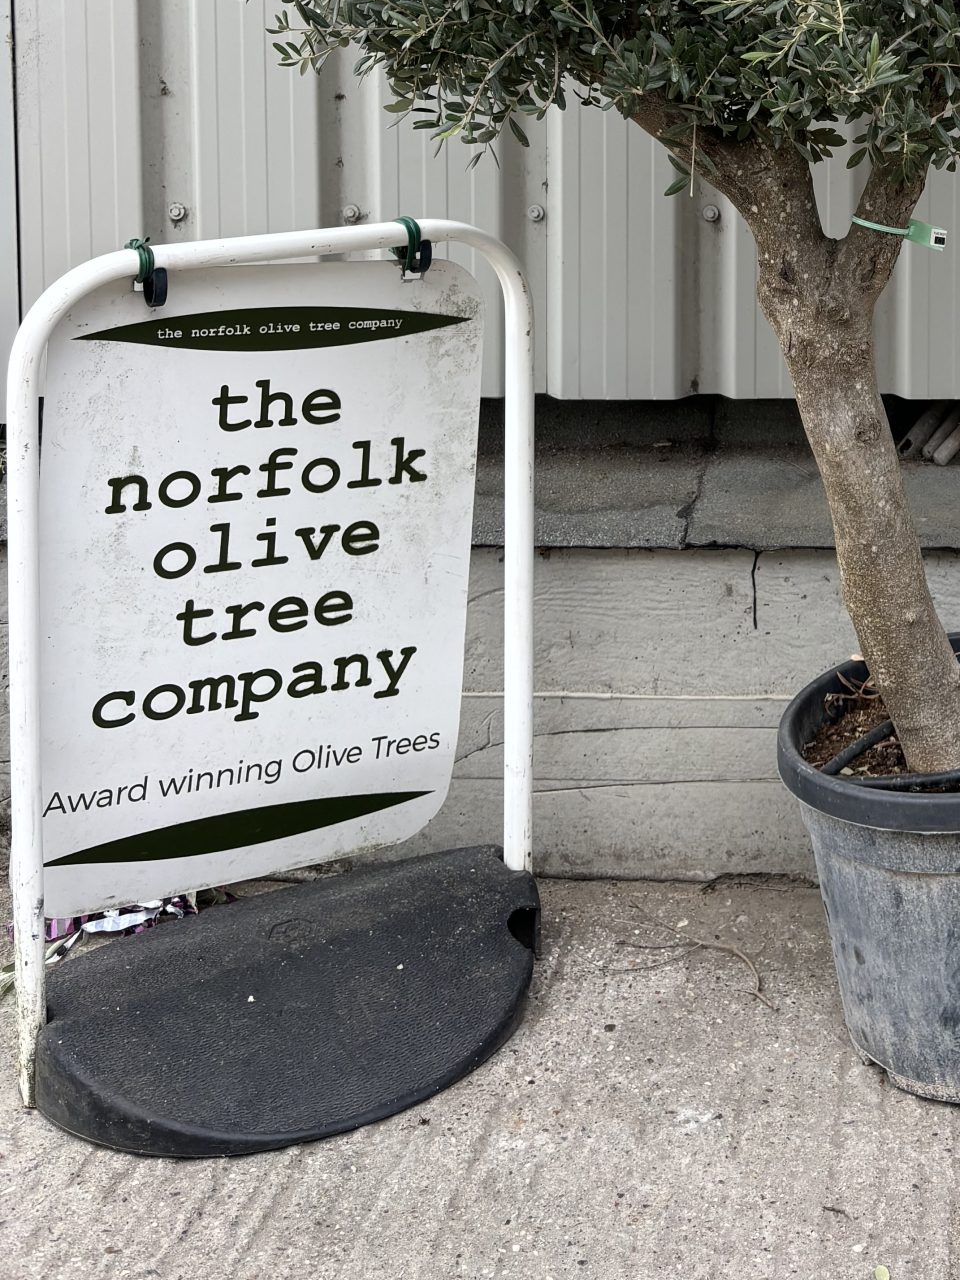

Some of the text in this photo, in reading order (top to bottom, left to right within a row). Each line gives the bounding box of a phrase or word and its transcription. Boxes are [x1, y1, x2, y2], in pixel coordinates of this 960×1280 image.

[156, 317, 403, 340] the norfolk olive tree company
[212, 379, 342, 432] the
[105, 436, 428, 515] norfolk
[153, 517, 380, 580] olive
[176, 589, 354, 647] tree
[92, 646, 417, 729] company
[42, 731, 441, 819] Award winning Olive Trees
